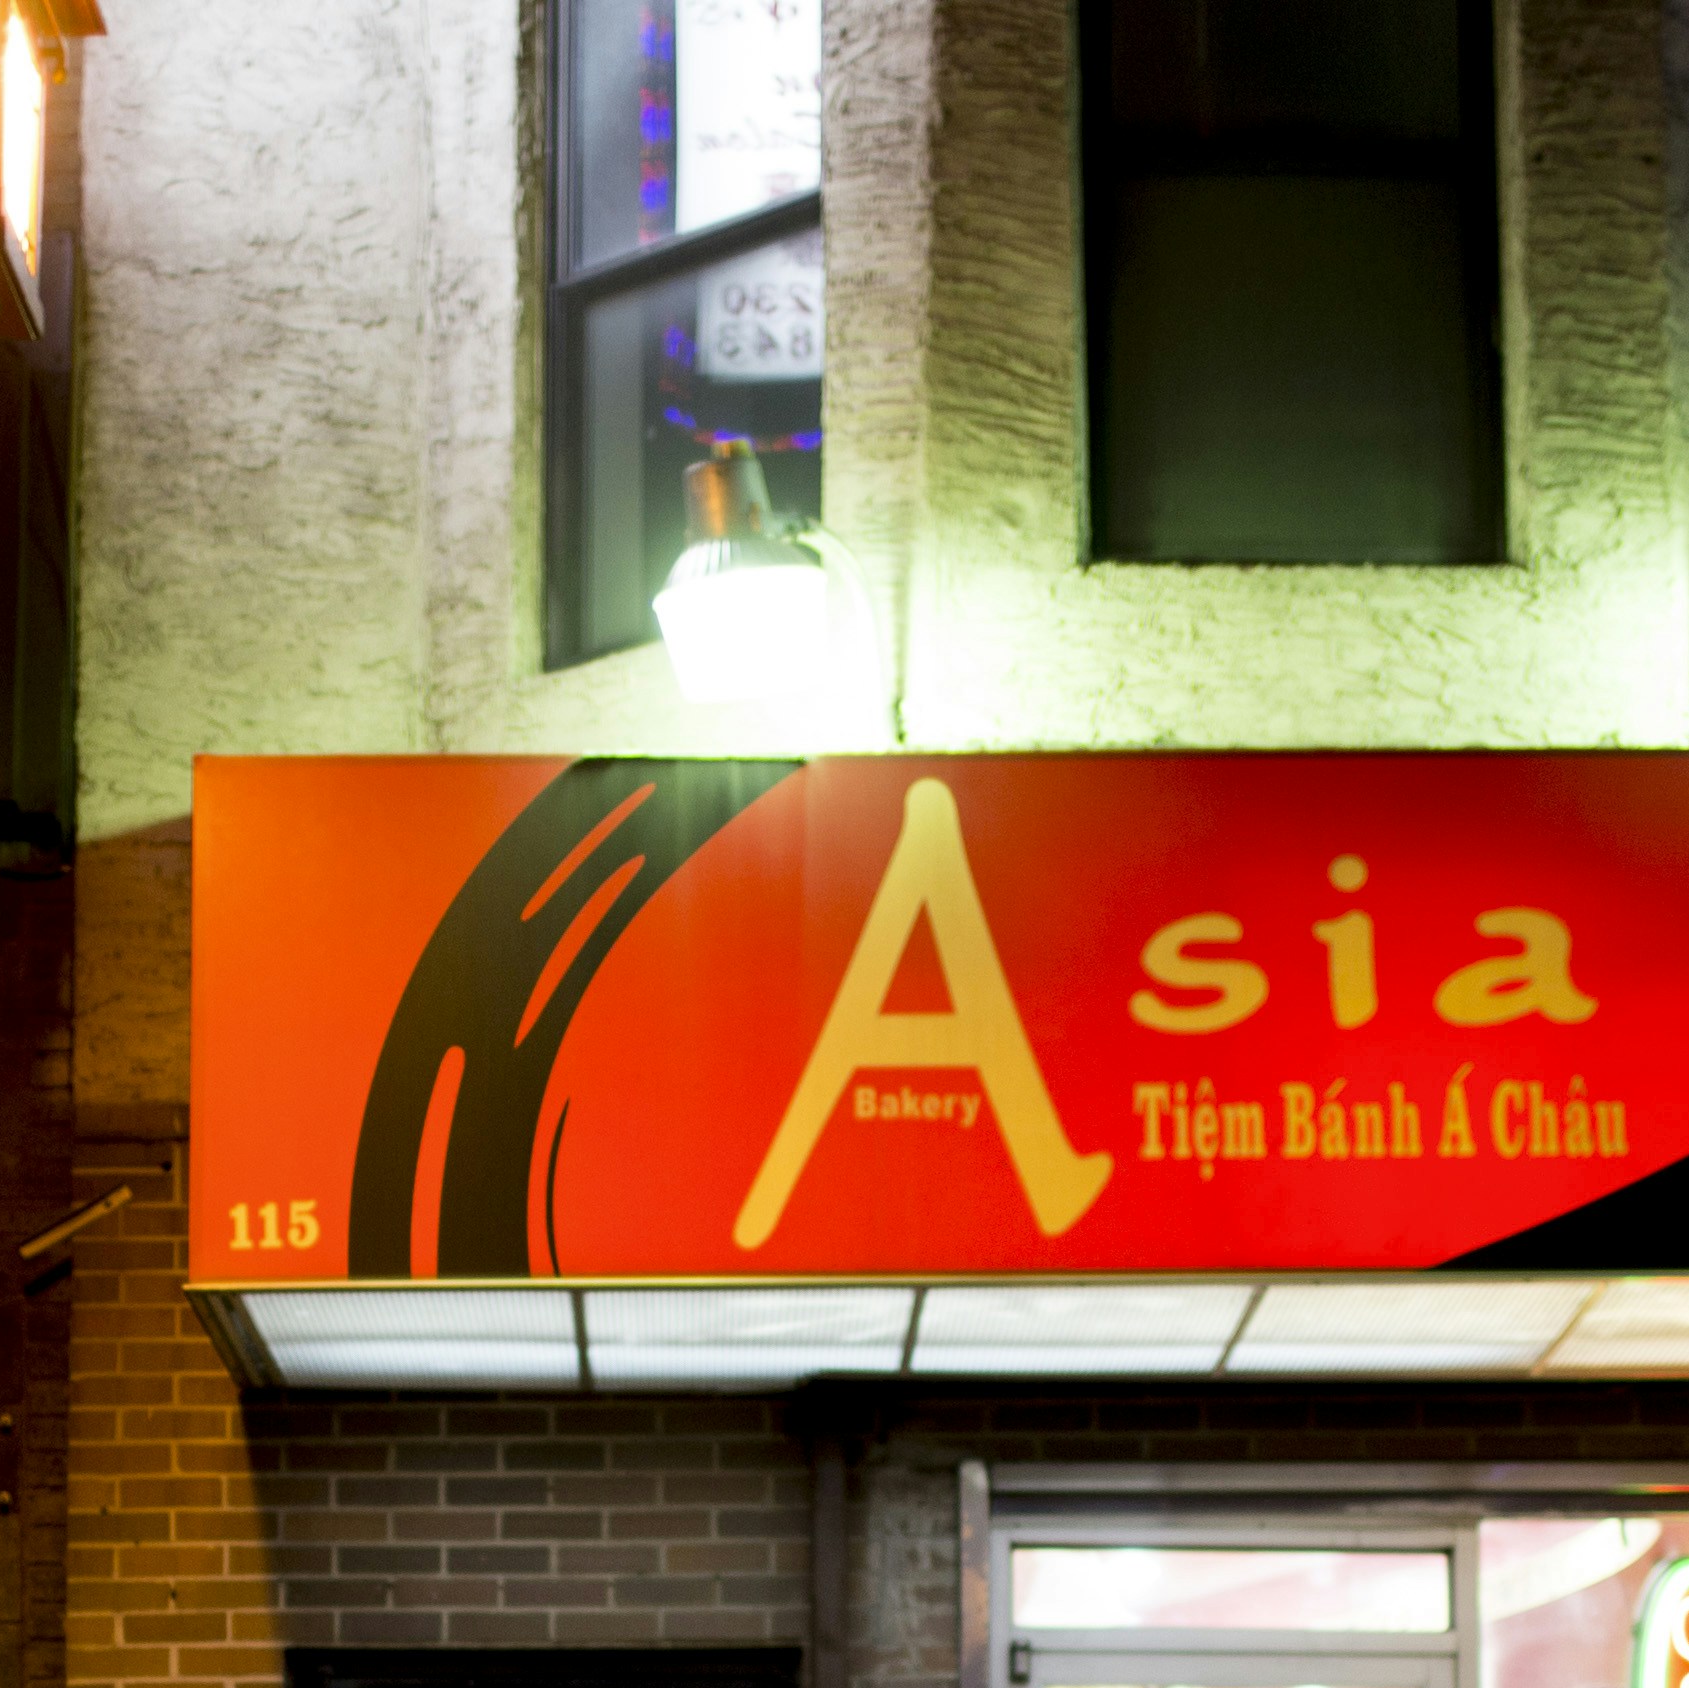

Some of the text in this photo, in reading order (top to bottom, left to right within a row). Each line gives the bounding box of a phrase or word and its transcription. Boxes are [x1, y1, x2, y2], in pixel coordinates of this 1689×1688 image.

[733, 777, 1598, 1250] Asia
[854, 1086, 980, 1127] Bakery
[1134, 1062, 1628, 1181] Tiệm Bánh Á Châu
[229, 1200, 319, 1249] 115
